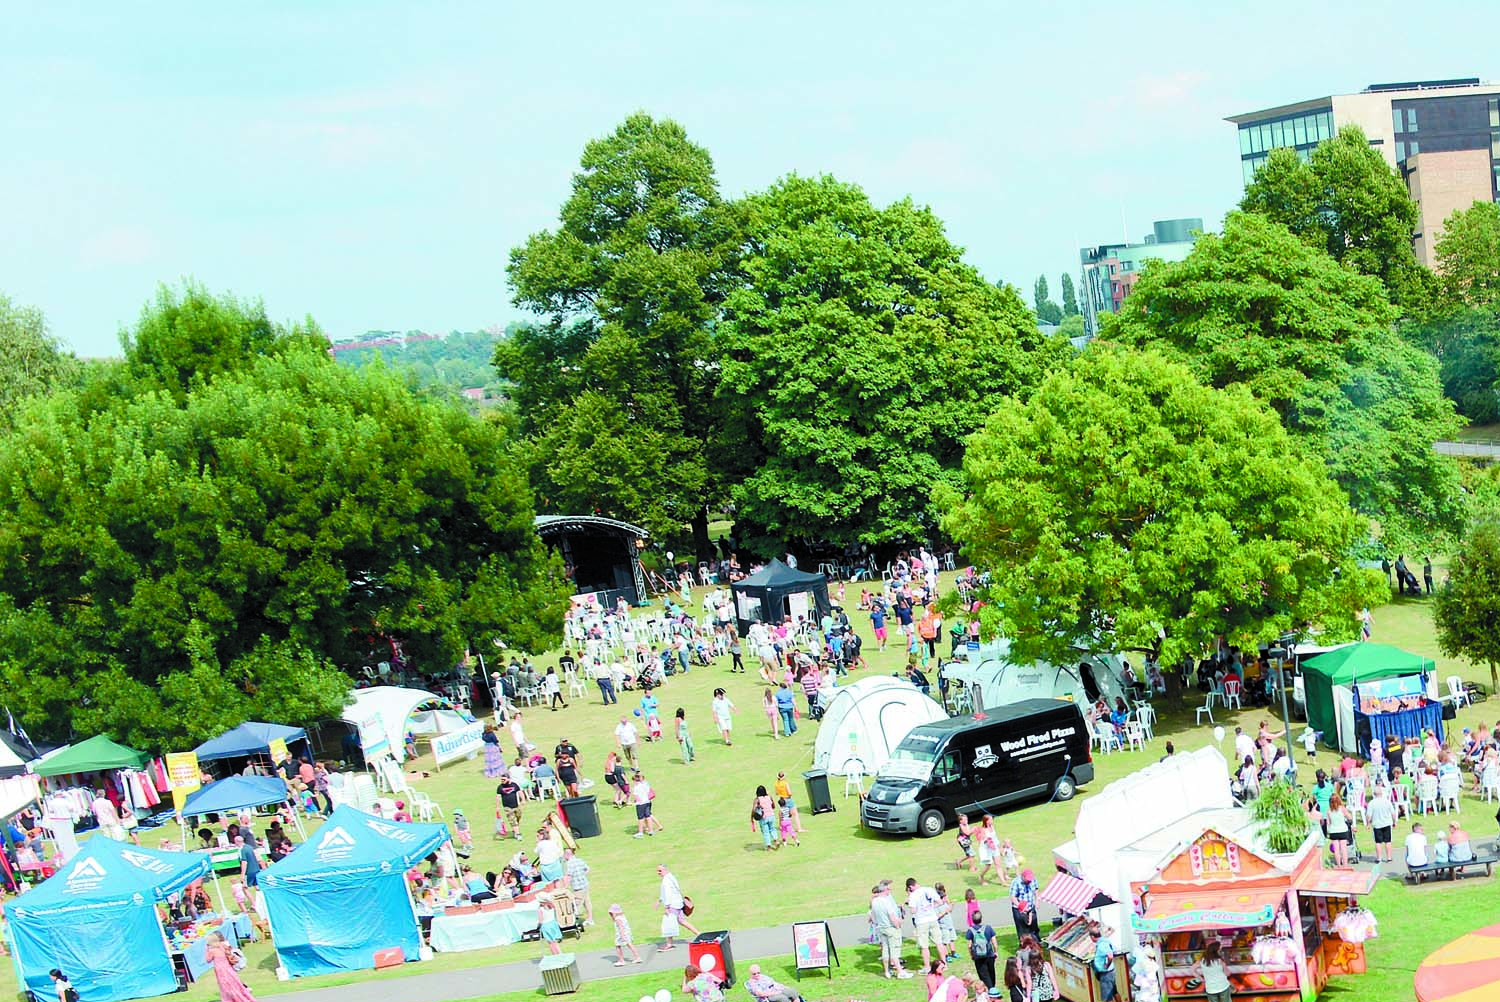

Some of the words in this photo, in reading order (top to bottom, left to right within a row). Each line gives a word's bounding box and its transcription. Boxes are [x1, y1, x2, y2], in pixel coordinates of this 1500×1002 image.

[1000, 737, 1026, 752] Wood
[1026, 731, 1050, 746] Fired
[1051, 727, 1076, 739] Pizza
